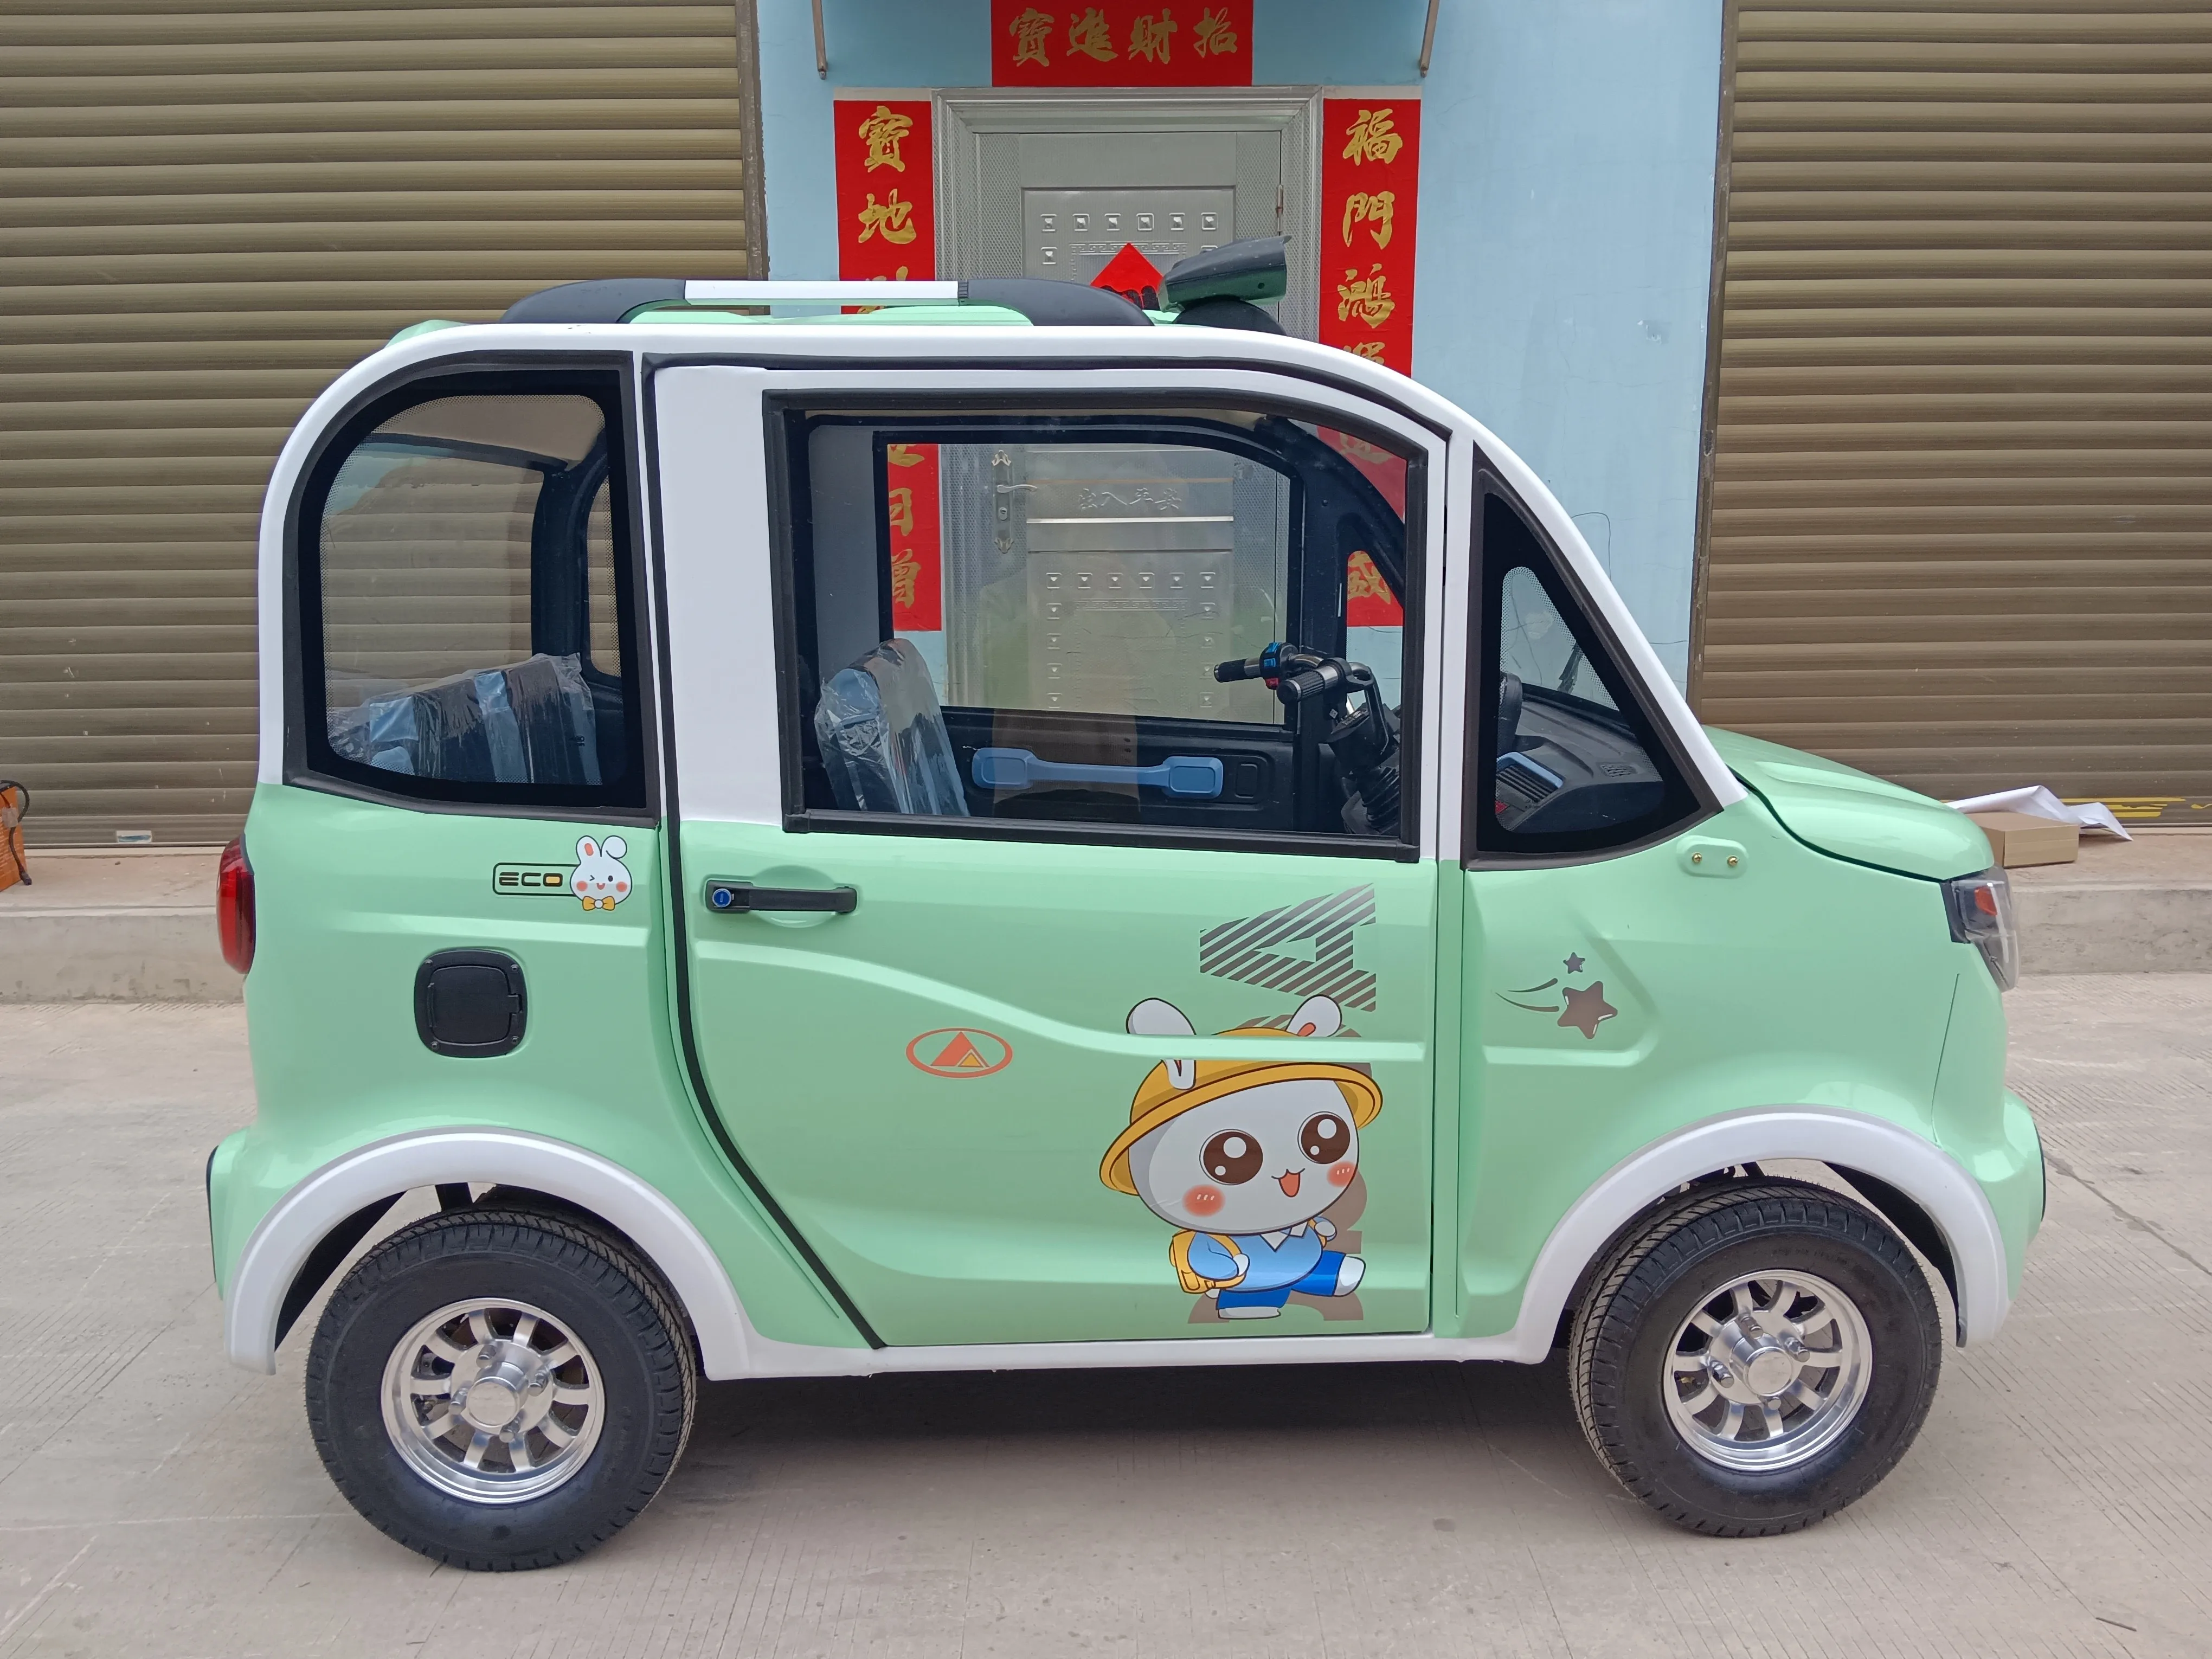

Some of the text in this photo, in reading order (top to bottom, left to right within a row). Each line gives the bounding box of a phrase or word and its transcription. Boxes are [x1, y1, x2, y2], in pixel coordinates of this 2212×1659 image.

[1078, 487, 1182, 510] 出入平安
[499, 871, 563, 888] ECO
